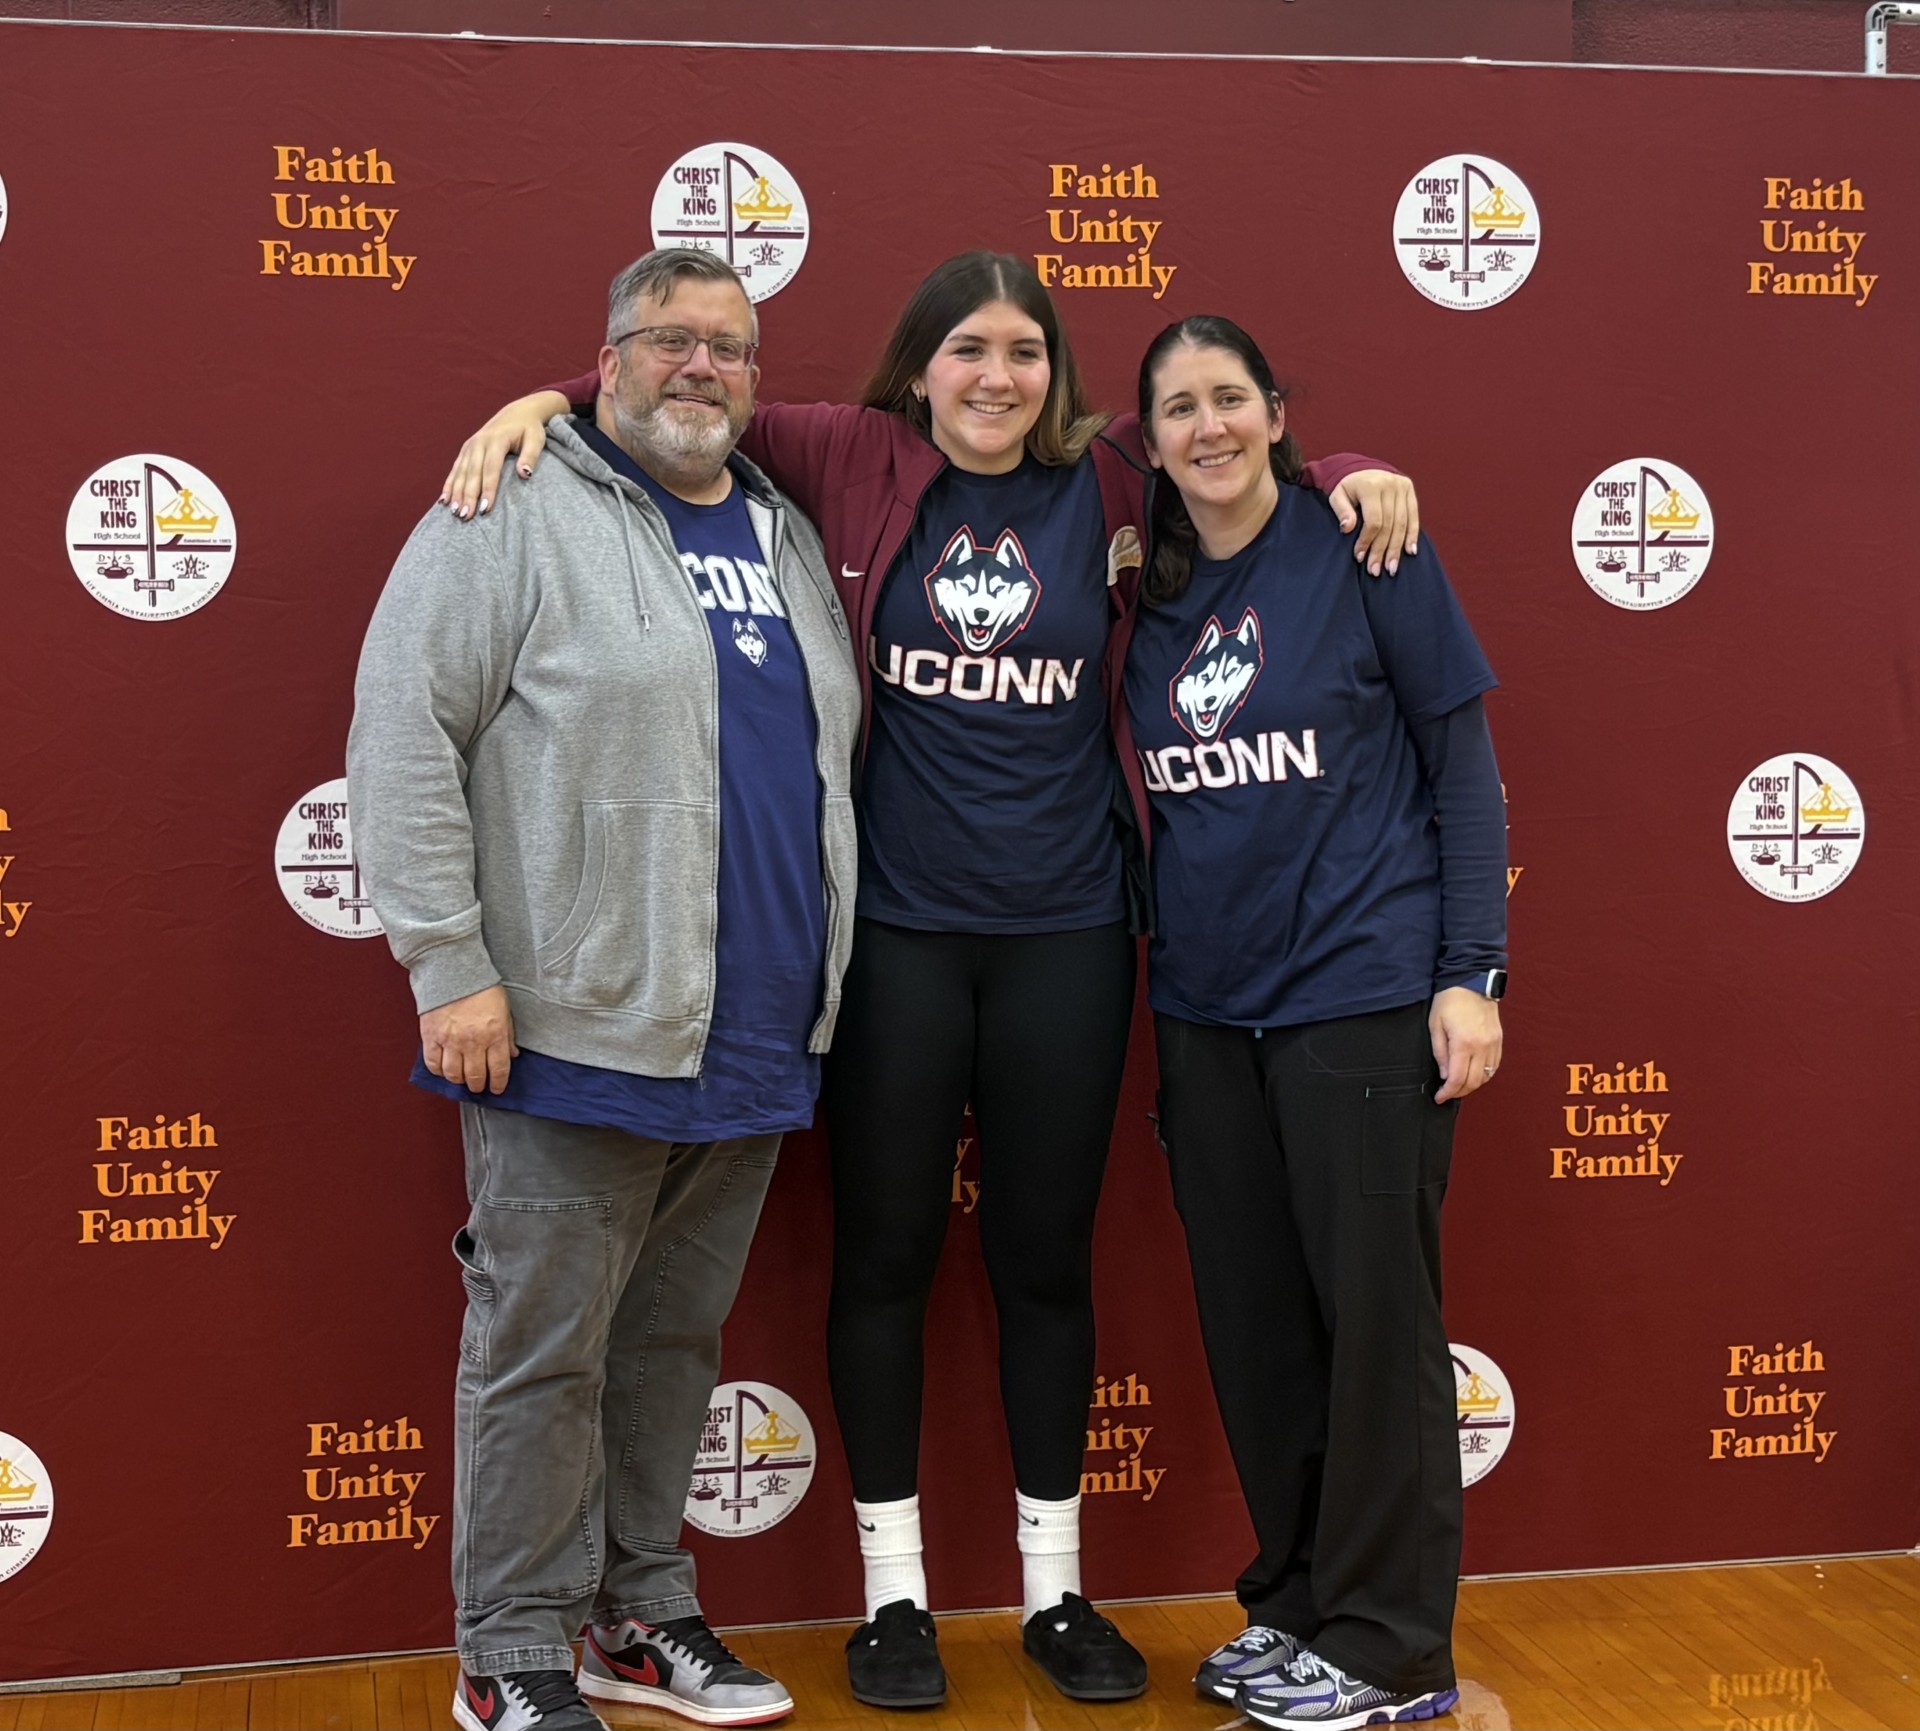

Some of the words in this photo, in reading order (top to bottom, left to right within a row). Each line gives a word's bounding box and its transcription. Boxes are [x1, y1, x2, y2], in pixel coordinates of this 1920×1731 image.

[272, 145, 396, 185] Faith
[673, 166, 720, 185] CHRIST
[1048, 163, 1160, 198] Faith
[690, 185, 708, 197] THE
[1415, 178, 1459, 195] CHRIST
[1430, 195, 1447, 207] THE
[1763, 177, 1865, 211] Faith
[270, 192, 400, 243] Unity
[683, 198, 717, 216] KING
[1423, 207, 1455, 224] KING
[1045, 208, 1163, 255] Unity
[1416, 227, 1433, 235] High
[1759, 220, 1867, 264] Unity
[258, 240, 418, 291] Family
[1033, 253, 1178, 300] Family
[1747, 262, 1879, 307] Family
[90, 479, 141, 497] CHRIST
[108, 498, 128, 511] THE
[1594, 482, 1637, 498] CHRIST
[1608, 498, 1625, 510] THE
[100, 511, 137, 529] KING
[1601, 510, 1632, 526] KING
[93, 532, 112, 540] High
[113, 532, 141, 540] School
[679, 552, 788, 619] CON
[868, 635, 1085, 705] UCONN
[1137, 729, 1318, 793] UCONN
[1748, 776, 1790, 793] CHRIST
[1763, 793, 1778, 804] THE
[299, 803, 347, 820] CHRIST
[316, 820, 335, 832] THE
[1755, 805, 1785, 820] KING
[308, 833, 343, 850] KING
[320, 853, 347, 861] School
[1566, 1060, 1670, 1095] Faith
[96, 1112, 219, 1151] Faith
[1562, 1103, 1671, 1145] Unity
[92, 1159, 221, 1205] Unity
[1549, 1143, 1684, 1186] Family
[77, 1203, 238, 1250] Family
[1726, 1339, 1826, 1377] Faith
[1089, 1372, 1152, 1408] ith
[1722, 1383, 1827, 1424] Unity
[706, 1406, 733, 1424] RIST
[306, 1416, 424, 1457] Faith
[1085, 1418, 1154, 1460] nity
[1708, 1421, 1838, 1464] Family
[302, 1463, 427, 1507] Unity
[1080, 1457, 1167, 1502] mily
[286, 1504, 441, 1550] Family
